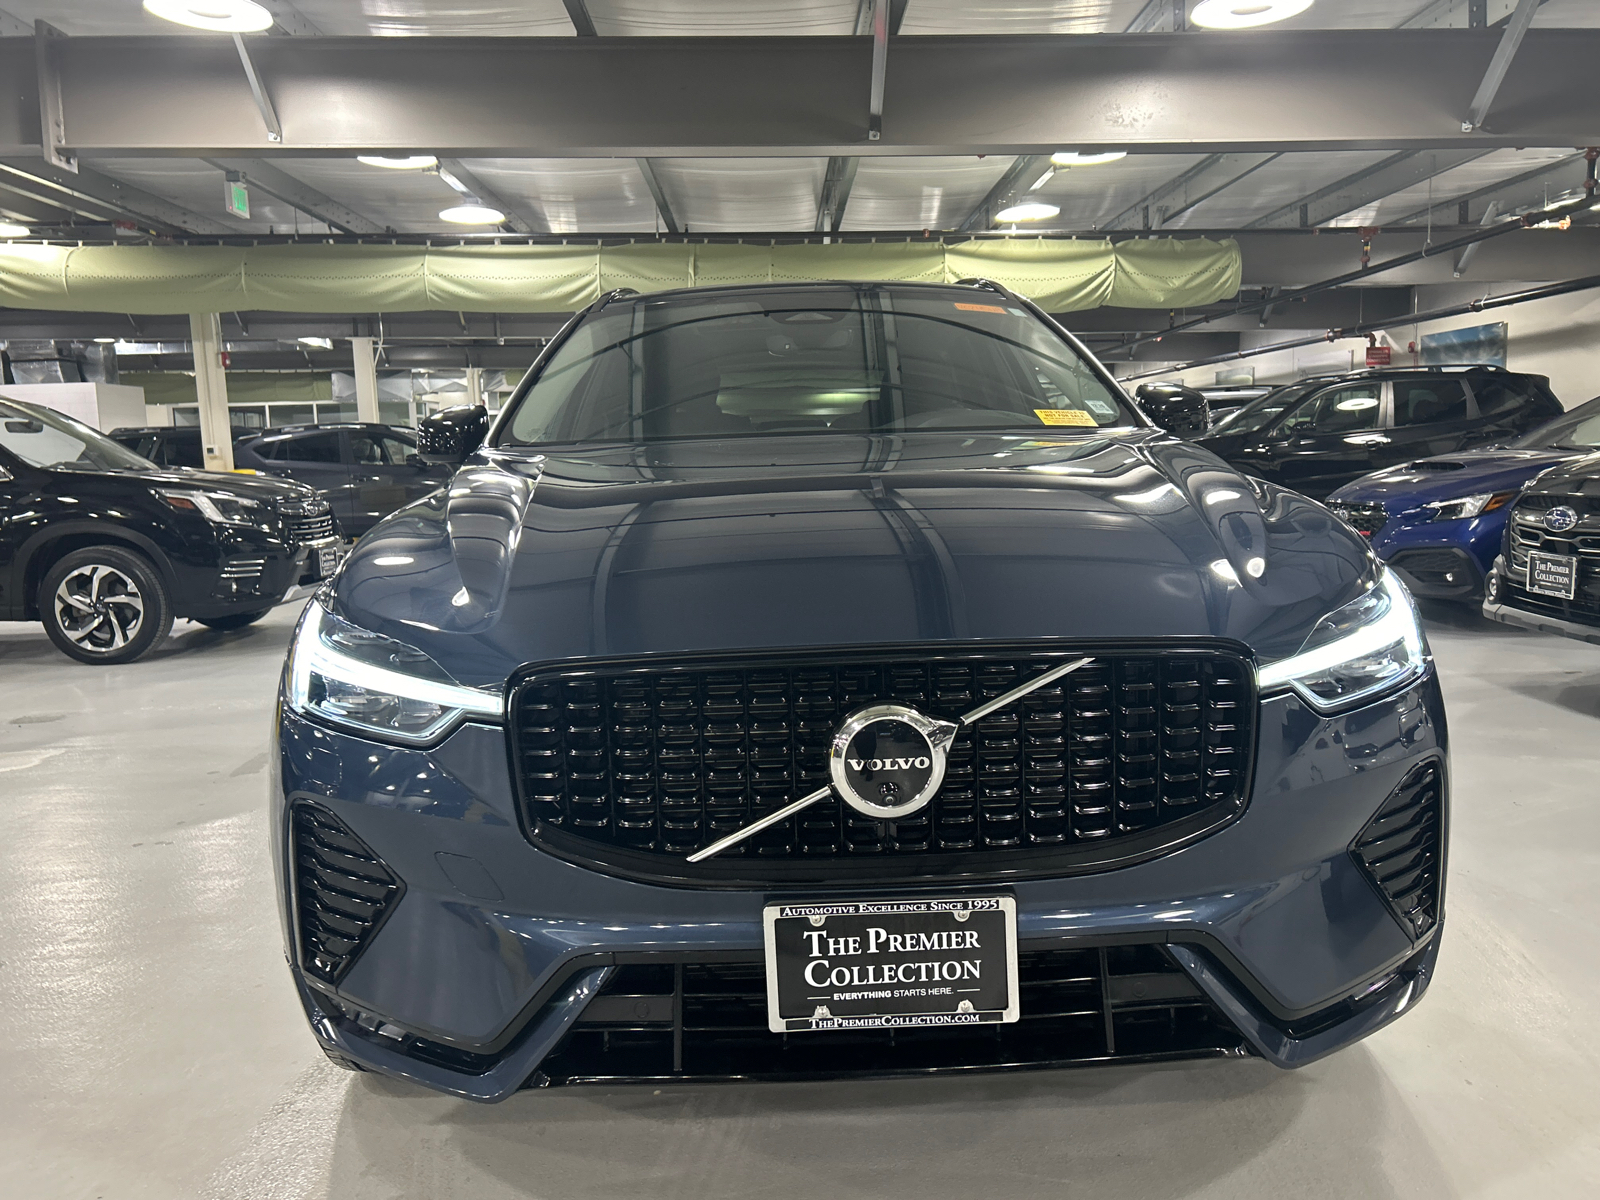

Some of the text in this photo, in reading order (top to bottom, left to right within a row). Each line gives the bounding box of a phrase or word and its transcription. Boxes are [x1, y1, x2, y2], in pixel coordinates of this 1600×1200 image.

[1535, 560, 1570, 574] THE PREMIER
[1534, 571, 1570, 584] COLLECTION
[847, 756, 930, 771] VOLVO
[782, 899, 998, 917] AUTOMOTIVE EXCELLENCE SINCE 1995
[803, 927, 981, 958] THE PREMIER
[804, 959, 982, 988] COLLECTION
[833, 987, 954, 1001] EVERYTHING STARTS HERE.
